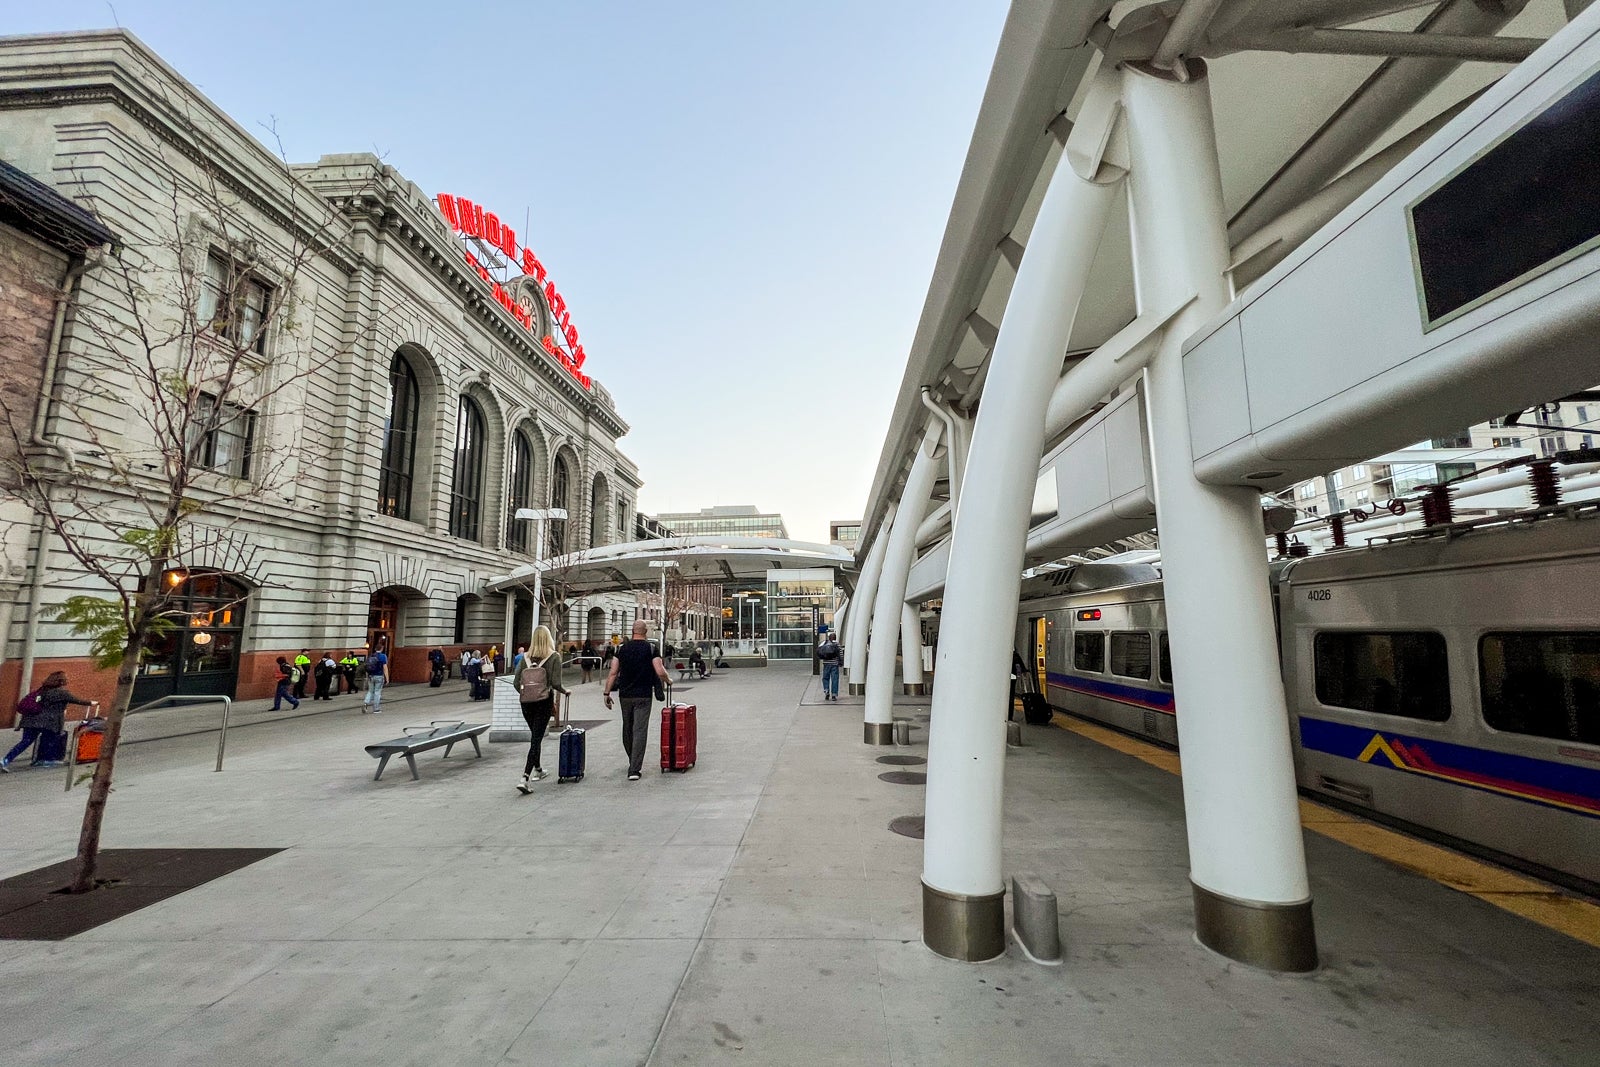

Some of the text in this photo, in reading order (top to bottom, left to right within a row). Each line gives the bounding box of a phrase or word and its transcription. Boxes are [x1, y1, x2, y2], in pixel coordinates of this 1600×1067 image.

[437, 192, 586, 370] UNION STATION
[490, 345, 527, 386] UNION
[534, 383, 569, 420] STATION
[1307, 588, 1331, 601] 4026
